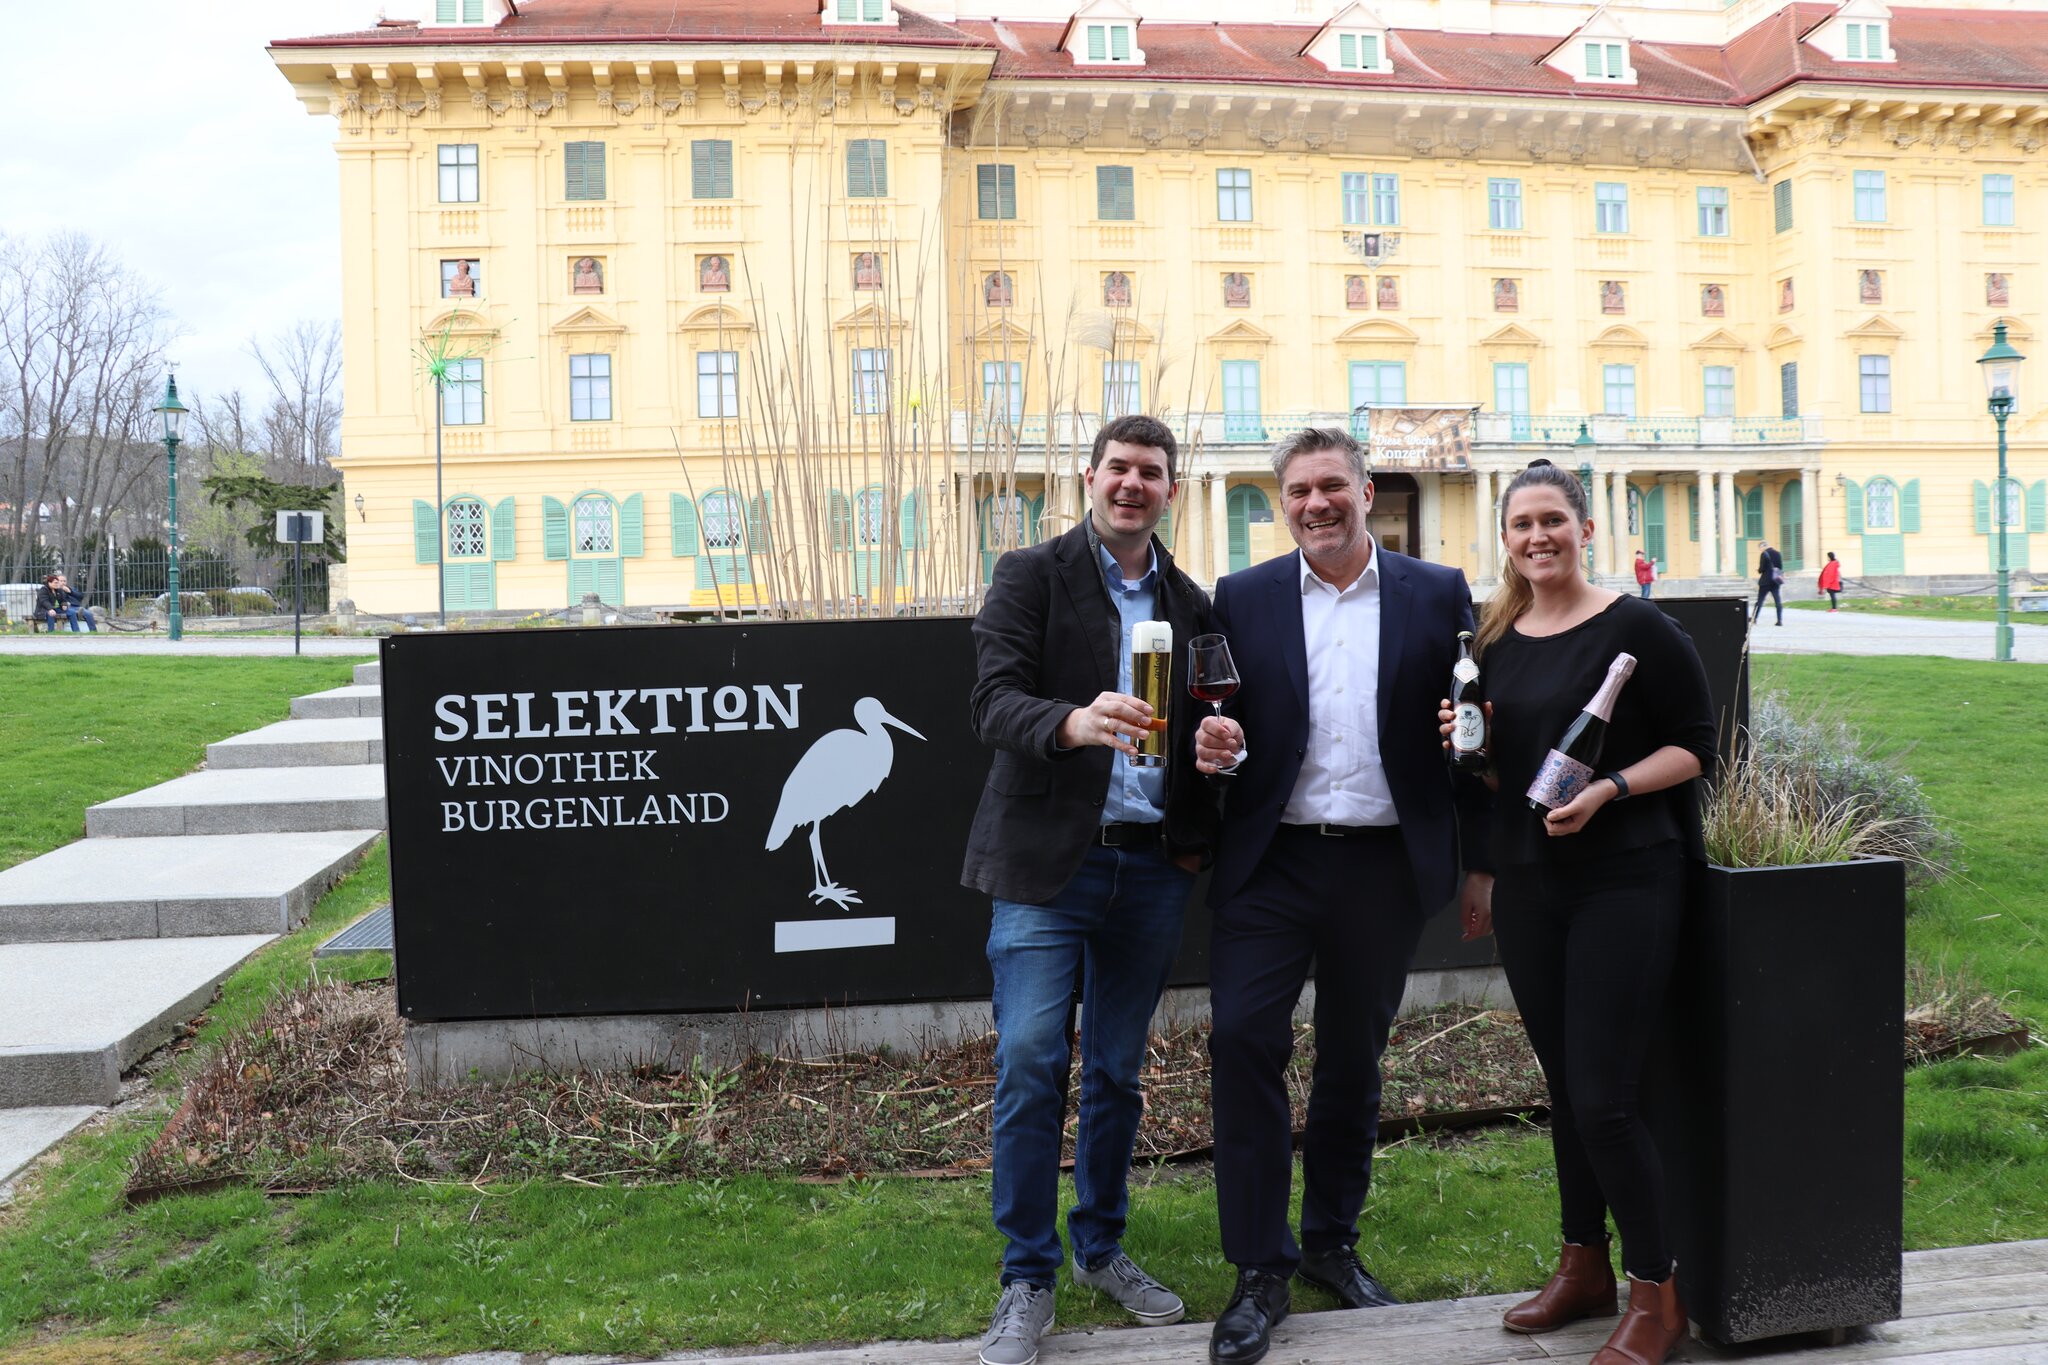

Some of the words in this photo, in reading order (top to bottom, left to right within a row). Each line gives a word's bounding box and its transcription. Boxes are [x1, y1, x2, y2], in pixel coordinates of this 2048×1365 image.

[1376, 434, 1402, 446] Diese
[1404, 434, 1437, 446] Woche
[1376, 446, 1428, 459] Konzert
[434, 683, 803, 741] SELEKTION
[435, 750, 660, 787] VINOTHEK
[440, 792, 729, 832] BURGENLAND
